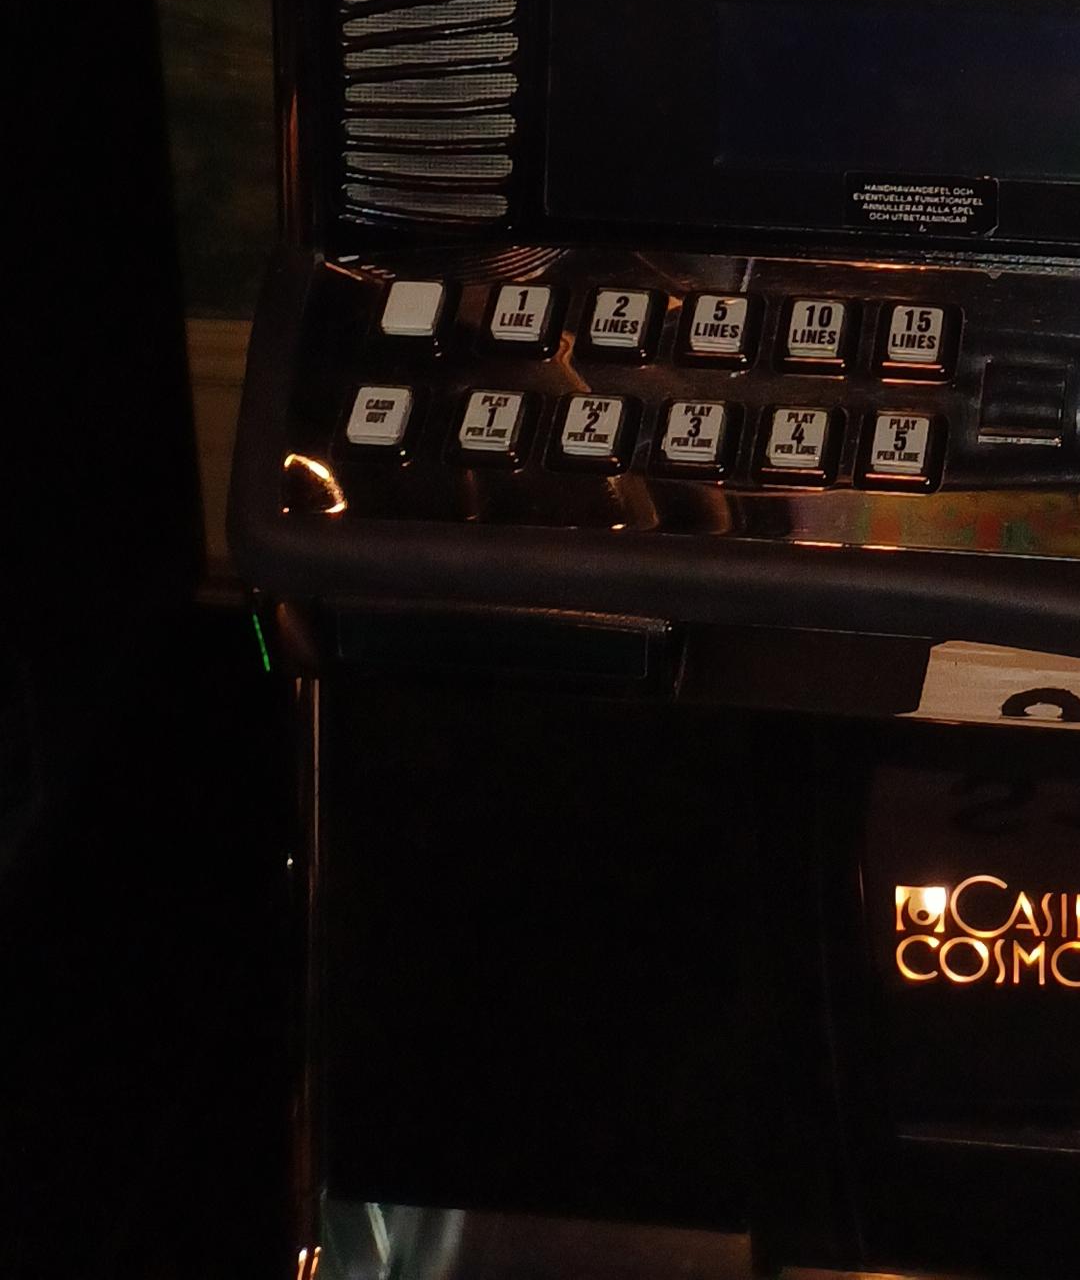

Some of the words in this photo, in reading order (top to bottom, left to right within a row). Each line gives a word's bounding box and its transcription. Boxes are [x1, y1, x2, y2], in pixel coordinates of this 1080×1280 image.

[853, 192, 912, 203] EVENTUELLA
[915, 195, 983, 206] FUNKTIONSFEL
[869, 212, 889, 221] OCH
[926, 205, 950, 214] ALLA
[953, 207, 975, 216] SPEL
[517, 290, 529, 312] 1
[612, 296, 630, 319] 2
[713, 299, 728, 322] 5
[805, 304, 833, 327] 10
[500, 312, 535, 328] LINE
[593, 318, 639, 335] LINES
[904, 309, 932, 333] 15
[694, 322, 740, 339] LINES
[791, 329, 837, 346] LINES
[891, 334, 937, 350] LINES
[365, 398, 395, 411] CASH
[481, 395, 510, 408] PLAY
[581, 399, 610, 413] PLAY
[486, 407, 497, 428] 1
[684, 405, 713, 417] PLAY
[787, 412, 816, 424] PLAY
[583, 412, 600, 433] 2
[687, 417, 703, 438] 3
[889, 418, 918, 431] PLAY
[790, 423, 805, 445] 4
[893, 430, 907, 451] 5
[774, 443, 795, 455] PER
[877, 450, 897, 462] PER
